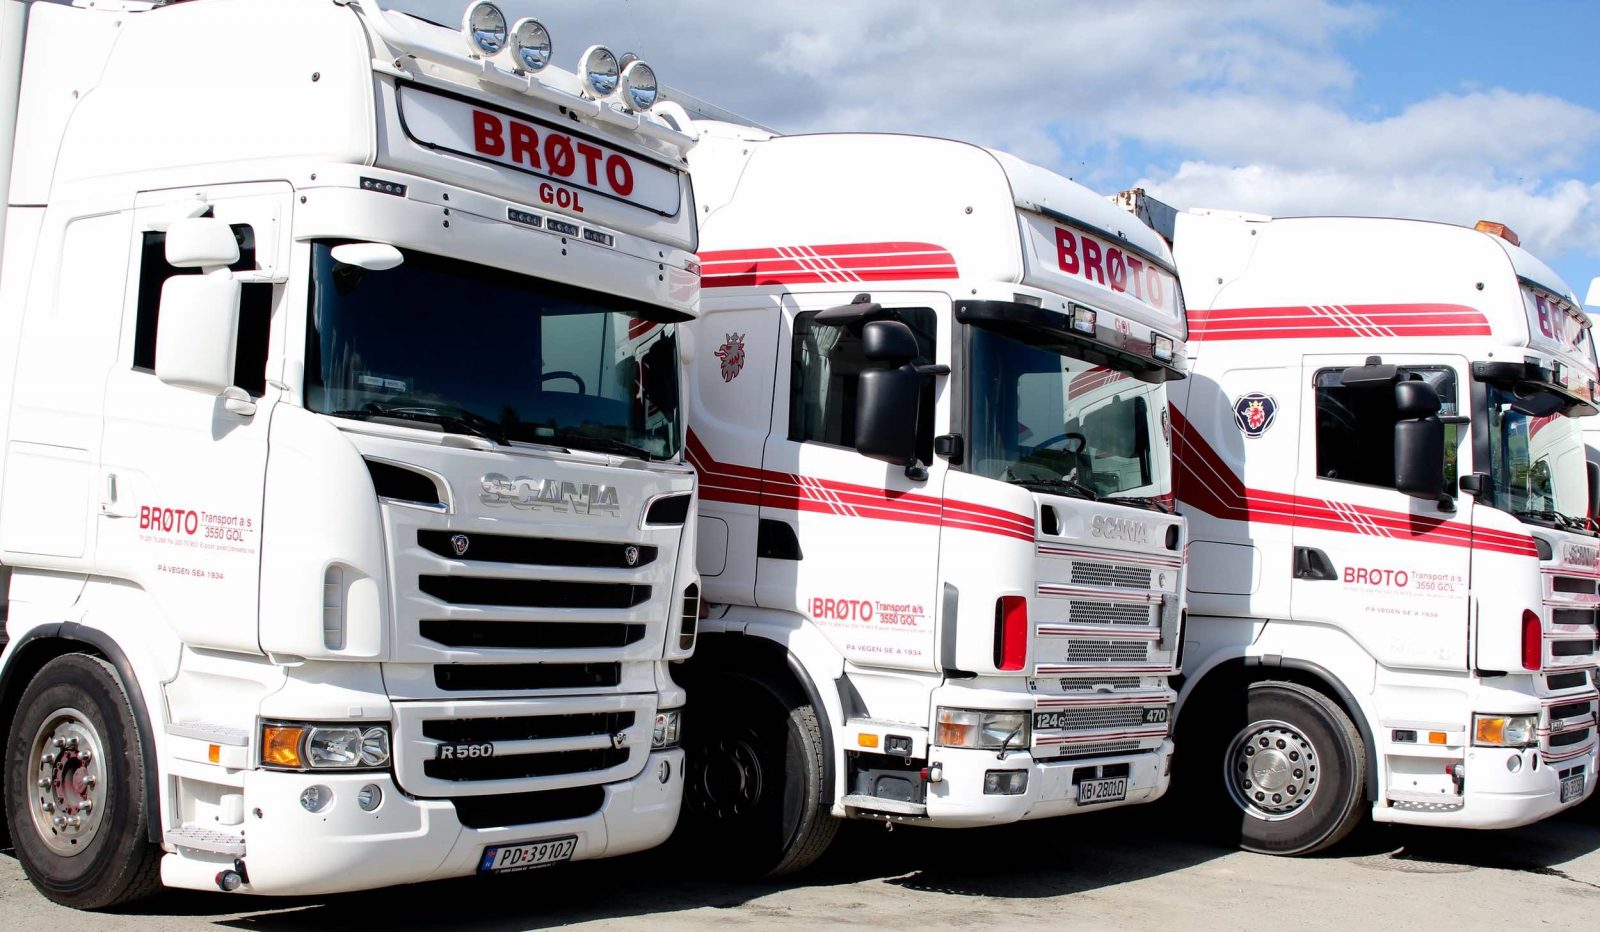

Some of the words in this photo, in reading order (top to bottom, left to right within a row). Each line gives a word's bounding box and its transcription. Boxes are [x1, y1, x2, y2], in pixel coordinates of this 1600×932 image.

[473, 110, 634, 197] BRØTO
[539, 182, 585, 213] GOL
[1055, 226, 1163, 309] BRØTO
[479, 472, 621, 518] SCANIA
[140, 505, 198, 535] BRØTO
[201, 511, 238, 527] Transport
[1092, 513, 1147, 543] SCANIA
[205, 527, 224, 540] 3550
[226, 528, 245, 542] GOL
[1343, 566, 1409, 588] BRØTO
[1411, 571, 1448, 582] Transport
[813, 597, 873, 622] BRØTO
[875, 601, 911, 614] Transport
[912, 604, 924, 614] a/s
[880, 612, 898, 625] 3550
[900, 614, 917, 626] GOL
[1146, 709, 1166, 723] 470
[440, 745, 453, 759] R
[456, 743, 493, 758] 560
[1096, 779, 1125, 799] 28010
[500, 848, 522, 866] PD
[527, 841, 573, 863] 39102
